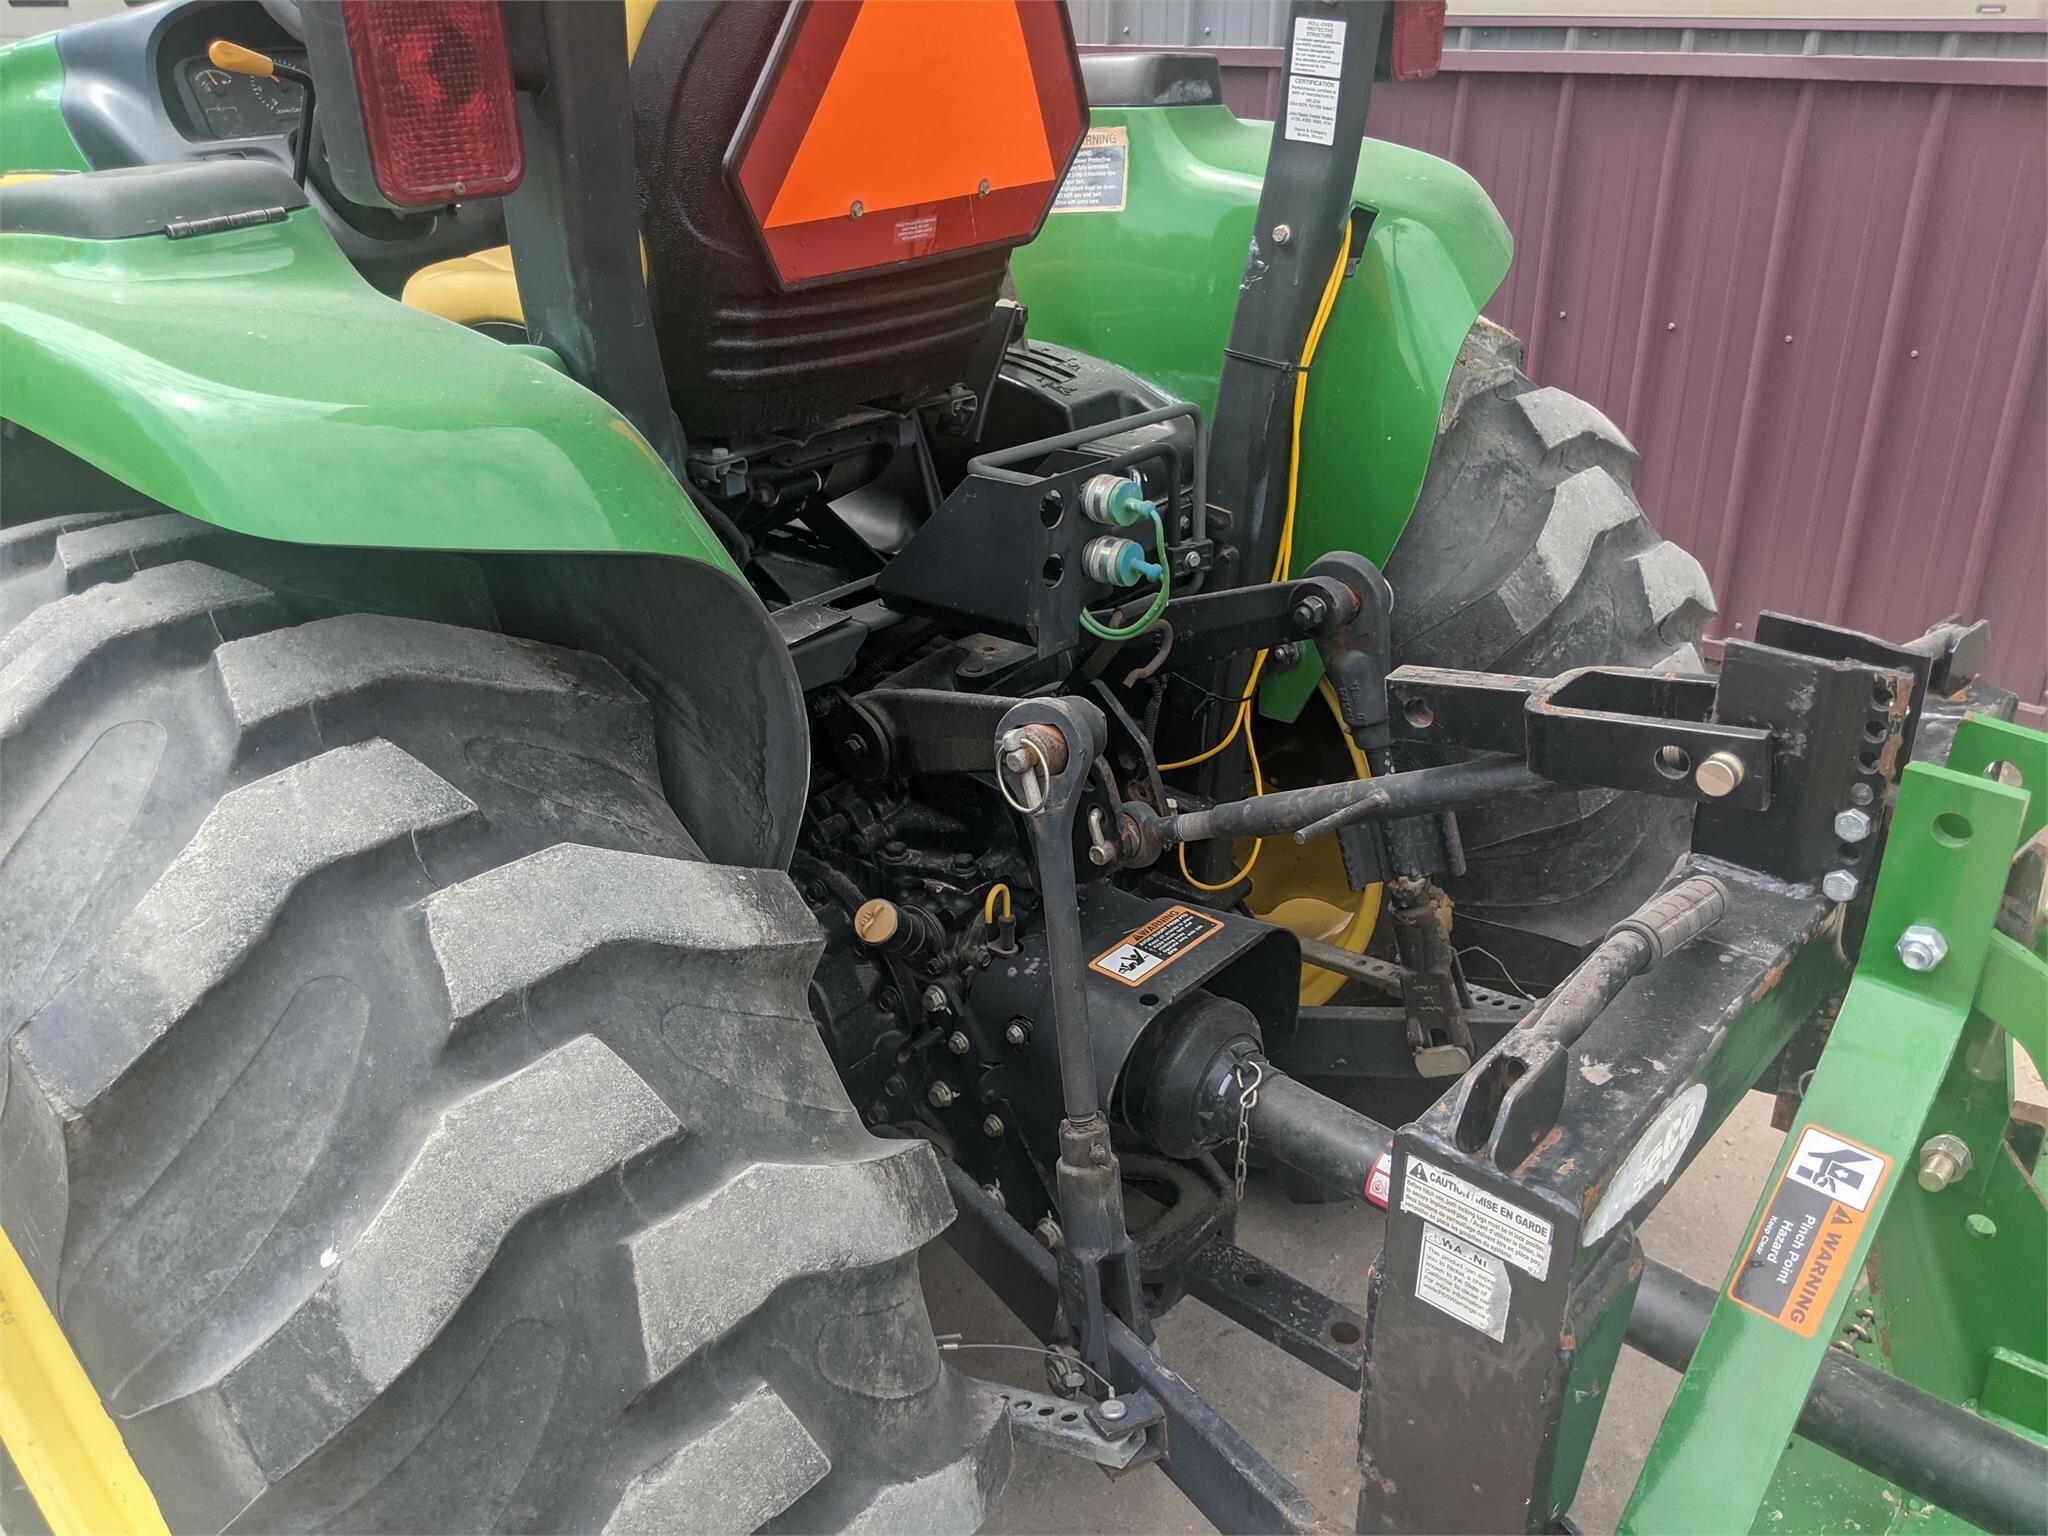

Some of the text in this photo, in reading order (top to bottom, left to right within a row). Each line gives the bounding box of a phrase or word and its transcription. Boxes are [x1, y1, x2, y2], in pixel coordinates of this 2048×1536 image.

[1295, 78, 1334, 87] CERTIFICATION
[1141, 911, 1179, 937] WARNING
[1405, 1193, 1417, 1203] deux
[1418, 1200, 1437, 1214] boulons
[1445, 1214, 1475, 1234] verrouillage
[1476, 1229, 1495, 1243] doivent
[1515, 1249, 1528, 1261] place
[1406, 1179, 1421, 1190] Before
[1422, 1187, 1434, 1197] hitch
[1435, 1194, 1445, 1203] use,
[1446, 1198, 1456, 1208] both
[1457, 1204, 1475, 1218] locking
[1476, 1214, 1486, 1224] lugs
[1487, 1220, 1499, 1230] must
[1501, 1226, 1508, 1234] be
[1514, 1232, 1524, 1242] lock
[1412, 1190, 1428, 1202] secure
[1429, 1198, 1454, 1216] implement
[1472, 1220, 1487, 1231] Avant
[1475, 1194, 1498, 1213] MISE
[1500, 1206, 1513, 1220] EN
[1515, 1213, 1547, 1237] GARDE
[1436, 1217, 1449, 1229] place
[1458, 1228, 1481, 1245] goupilles
[1755, 1214, 1778, 1255] Keep Clear
[1765, 1219, 1793, 1263] Hazard
[1776, 1213, 1816, 1285] Pinch Point
[1425, 1261, 1444, 1274] known
[1453, 1275, 1462, 1283] the
[1426, 1254, 1436, 1262] you
[1427, 1246, 1475, 1275] This product can
[1425, 1268, 1452, 1286] California
[1461, 1288, 1478, 1299] cause
[1435, 1281, 1450, 1292] more
[1452, 1289, 1483, 1310] information
[1788, 1229, 1842, 1326] WARNING
